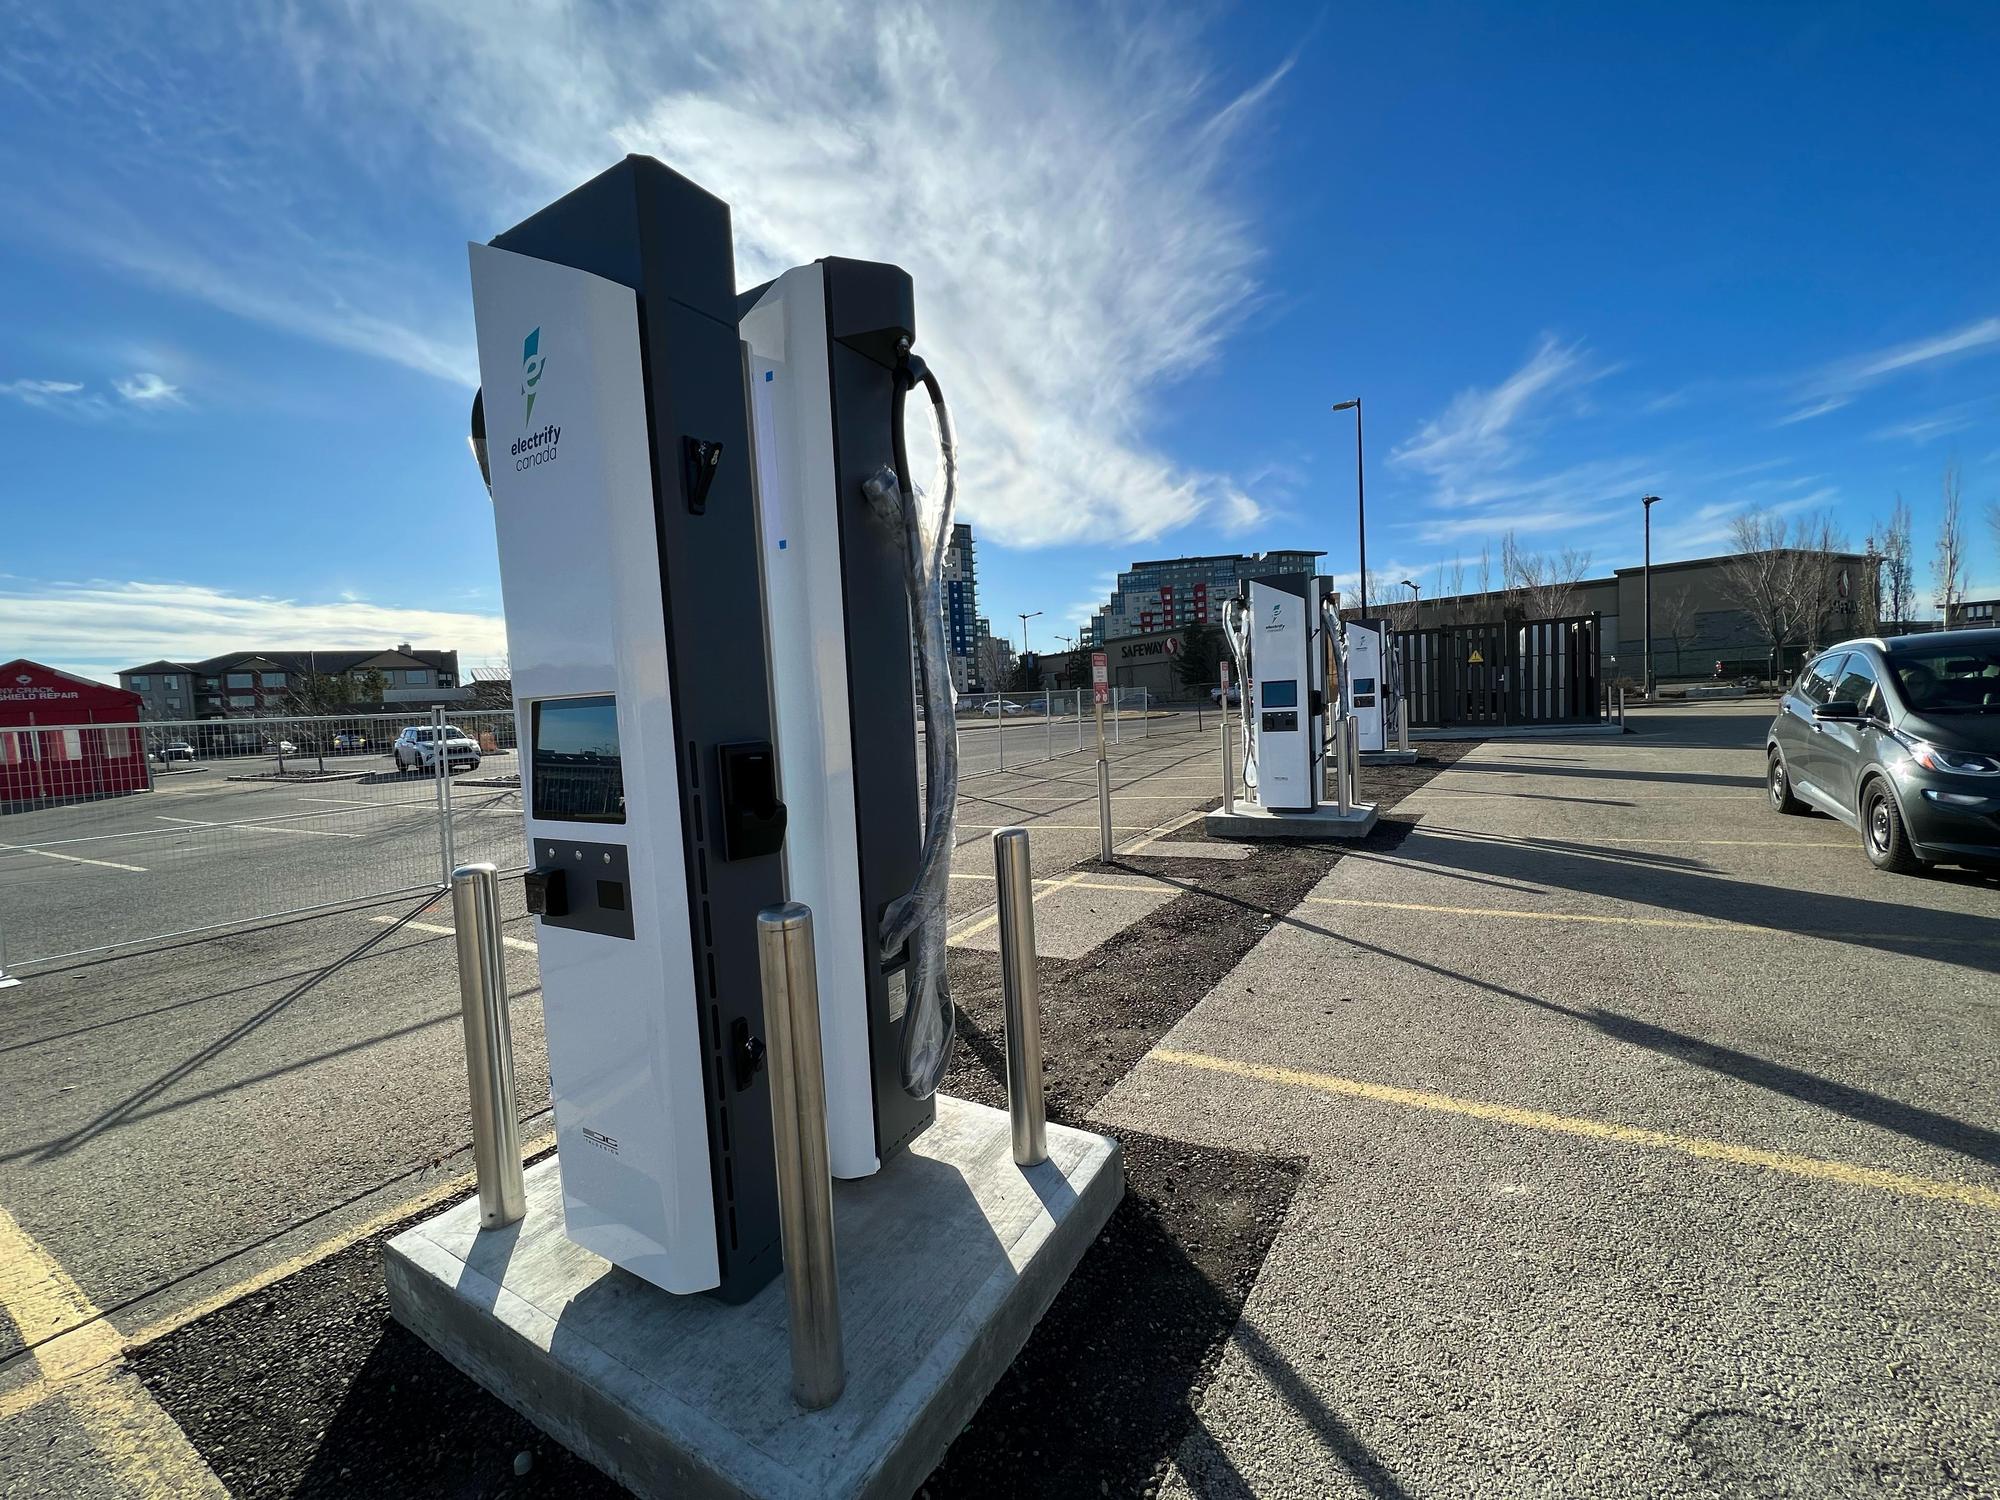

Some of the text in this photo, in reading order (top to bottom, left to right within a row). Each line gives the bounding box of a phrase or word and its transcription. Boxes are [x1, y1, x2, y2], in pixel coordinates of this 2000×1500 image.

[511, 425, 560, 455] electrify
[516, 444, 557, 471] canada
[1121, 640, 1164, 658] SAFEWAY
[39, 692, 79, 700] REPAIR
